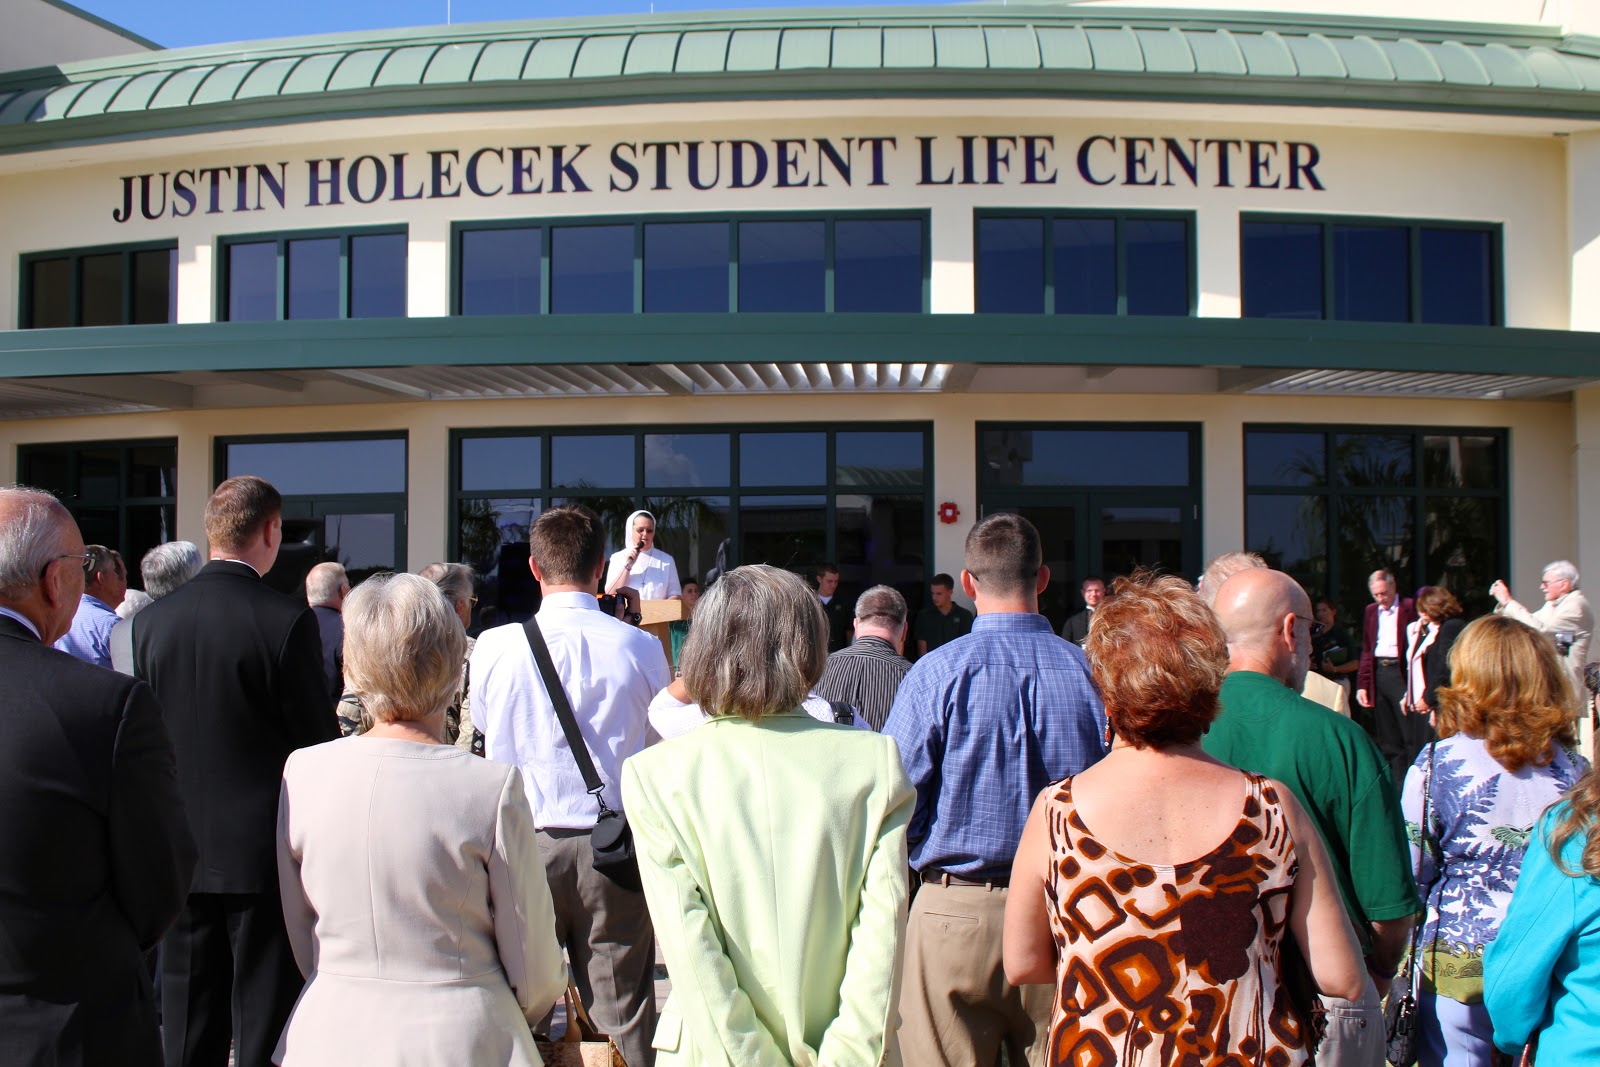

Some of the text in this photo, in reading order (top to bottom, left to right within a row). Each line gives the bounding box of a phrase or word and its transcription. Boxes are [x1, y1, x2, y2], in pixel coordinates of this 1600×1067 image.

[112, 134, 1326, 224] JUSTIN HOLECEK STUDENT LIFE CENTER
